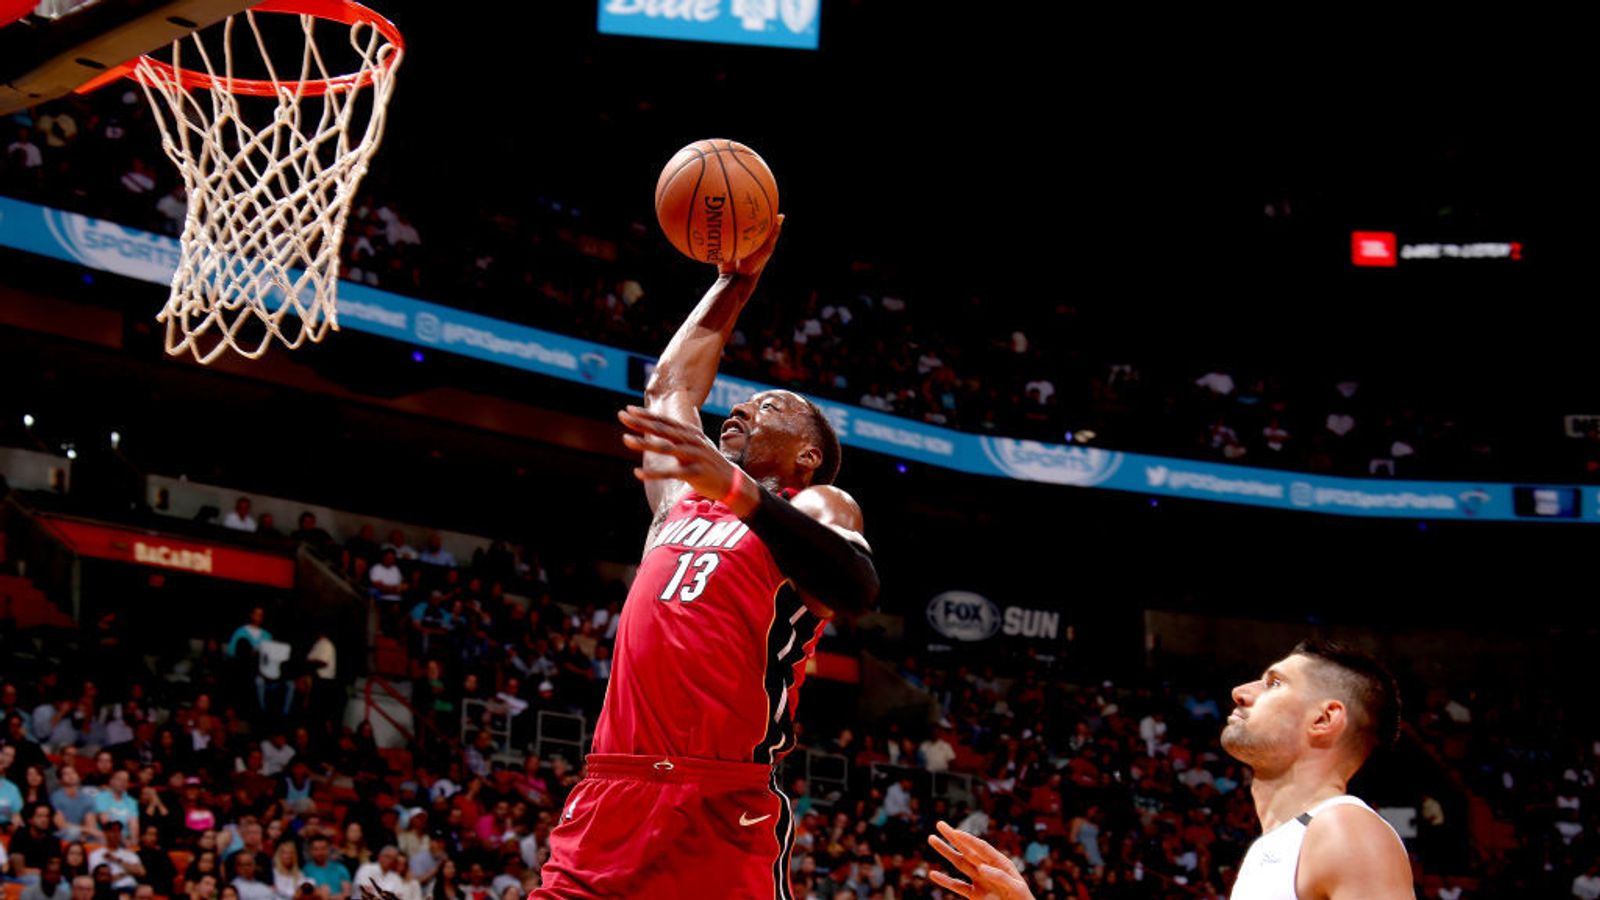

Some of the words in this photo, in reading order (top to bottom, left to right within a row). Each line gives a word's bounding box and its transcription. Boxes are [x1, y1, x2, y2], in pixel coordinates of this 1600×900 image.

[704, 196, 725, 262] PALDING
[658, 550, 721, 604] 13
[944, 600, 982, 621] FOX
[1002, 605, 1060, 640] SUN
